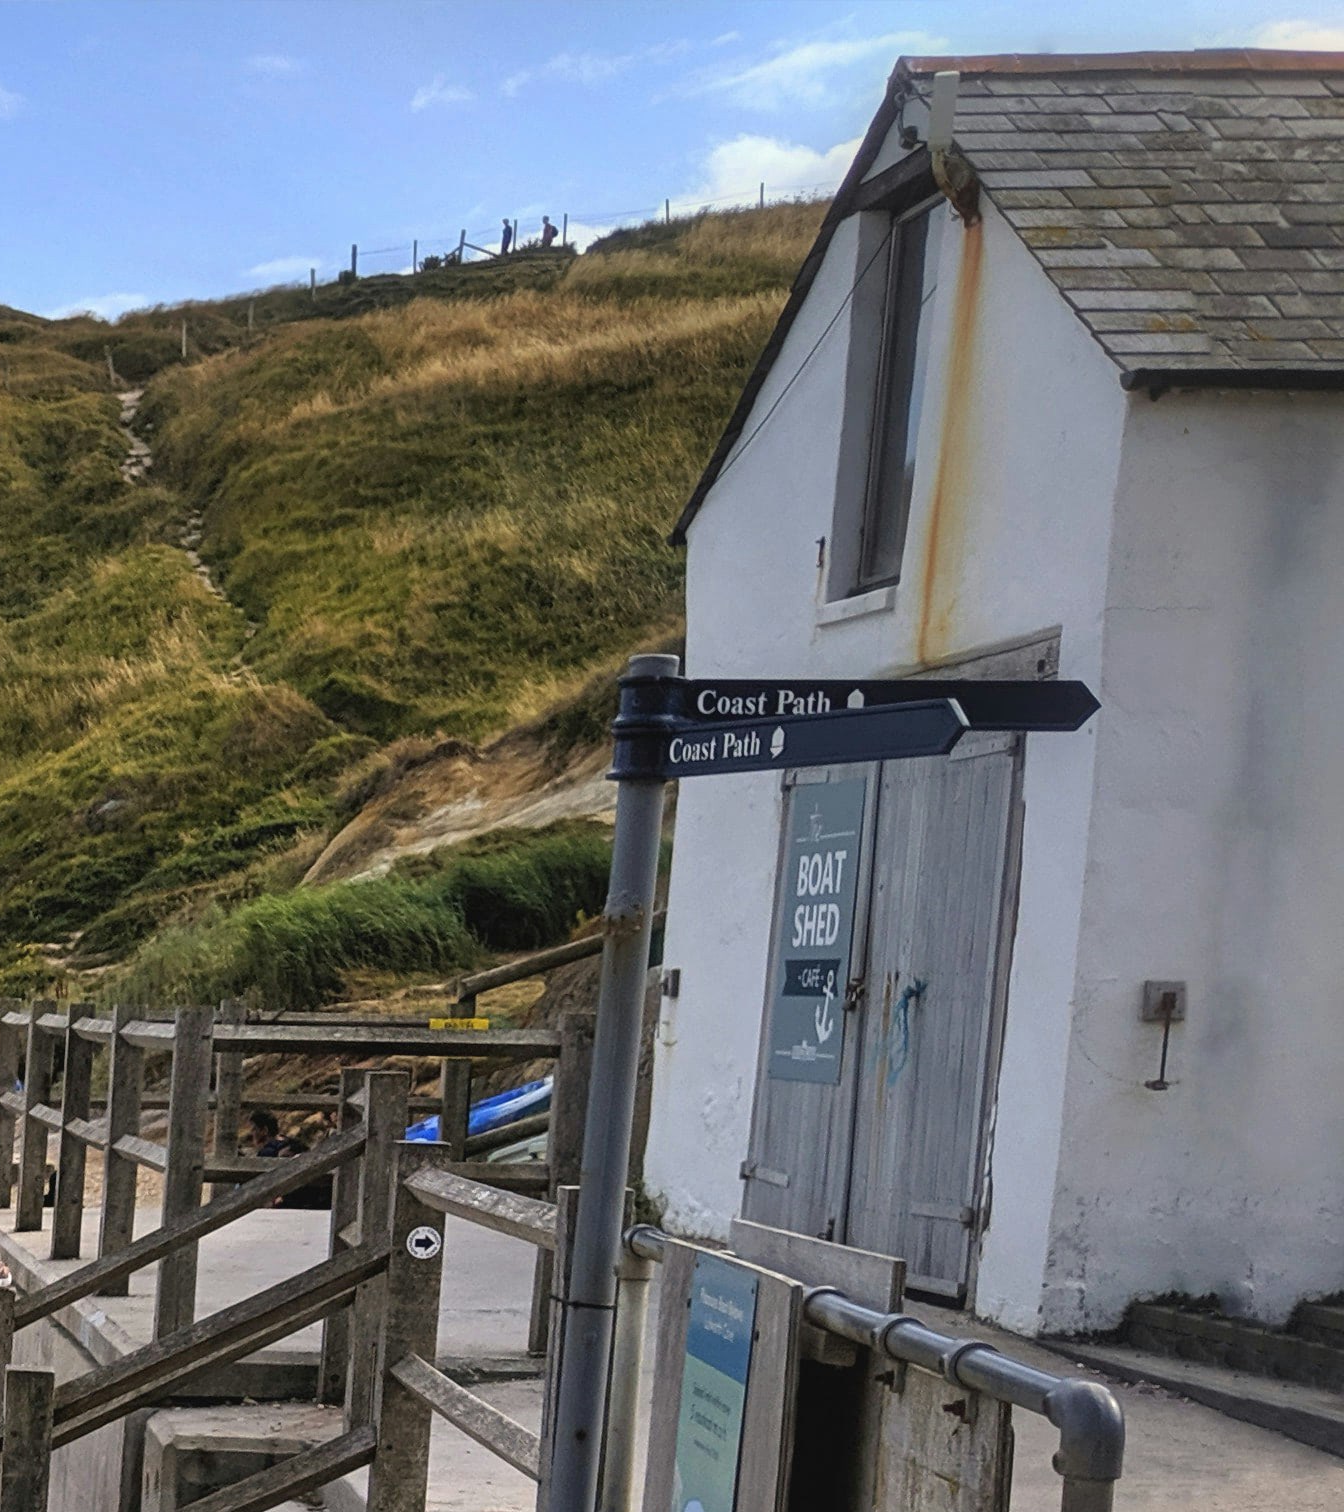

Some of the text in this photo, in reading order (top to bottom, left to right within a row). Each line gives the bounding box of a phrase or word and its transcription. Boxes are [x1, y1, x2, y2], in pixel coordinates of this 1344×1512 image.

[696, 689, 831, 715] Coast Path
[669, 730, 761, 764] Coast Path
[796, 849, 847, 897] BOAT
[792, 902, 840, 948] SHED
